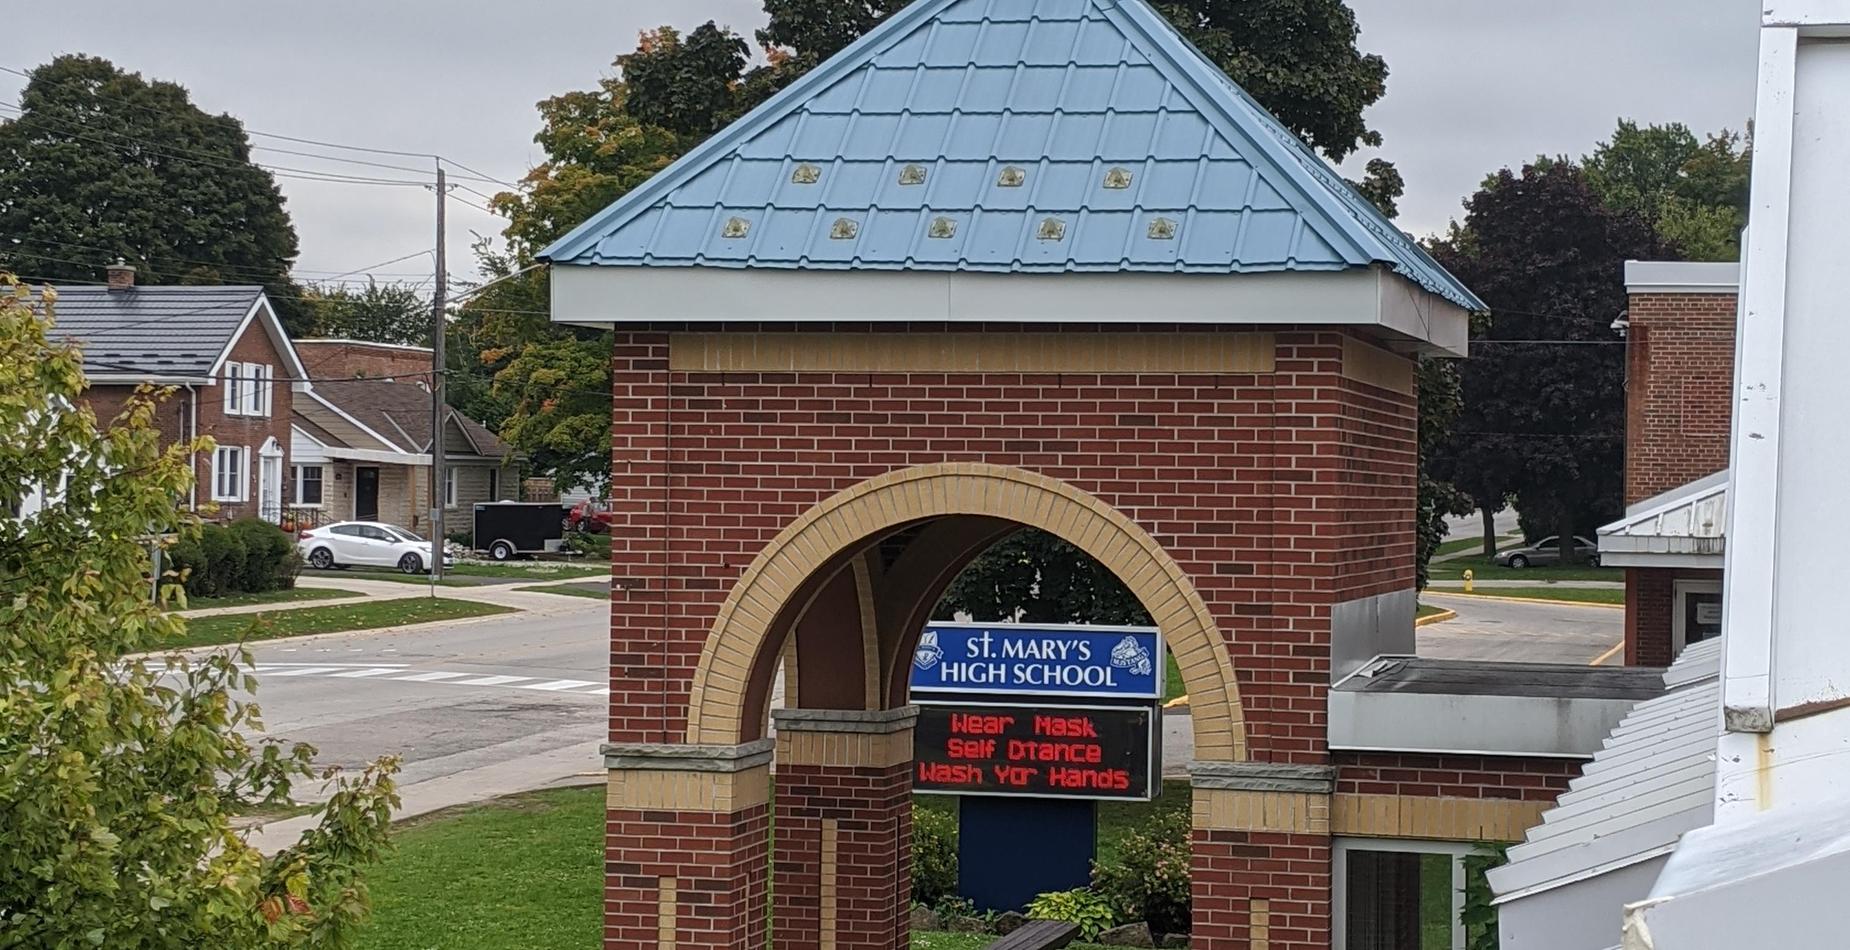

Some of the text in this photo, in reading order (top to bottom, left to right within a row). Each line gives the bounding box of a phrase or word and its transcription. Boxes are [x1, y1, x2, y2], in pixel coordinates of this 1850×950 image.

[941, 662, 1117, 686] HIGH SCHOOL
[951, 713, 1098, 738] Wear Mask
[947, 738, 996, 759] Self
[919, 762, 982, 784] Wash
[1049, 766, 1129, 789] Hands
